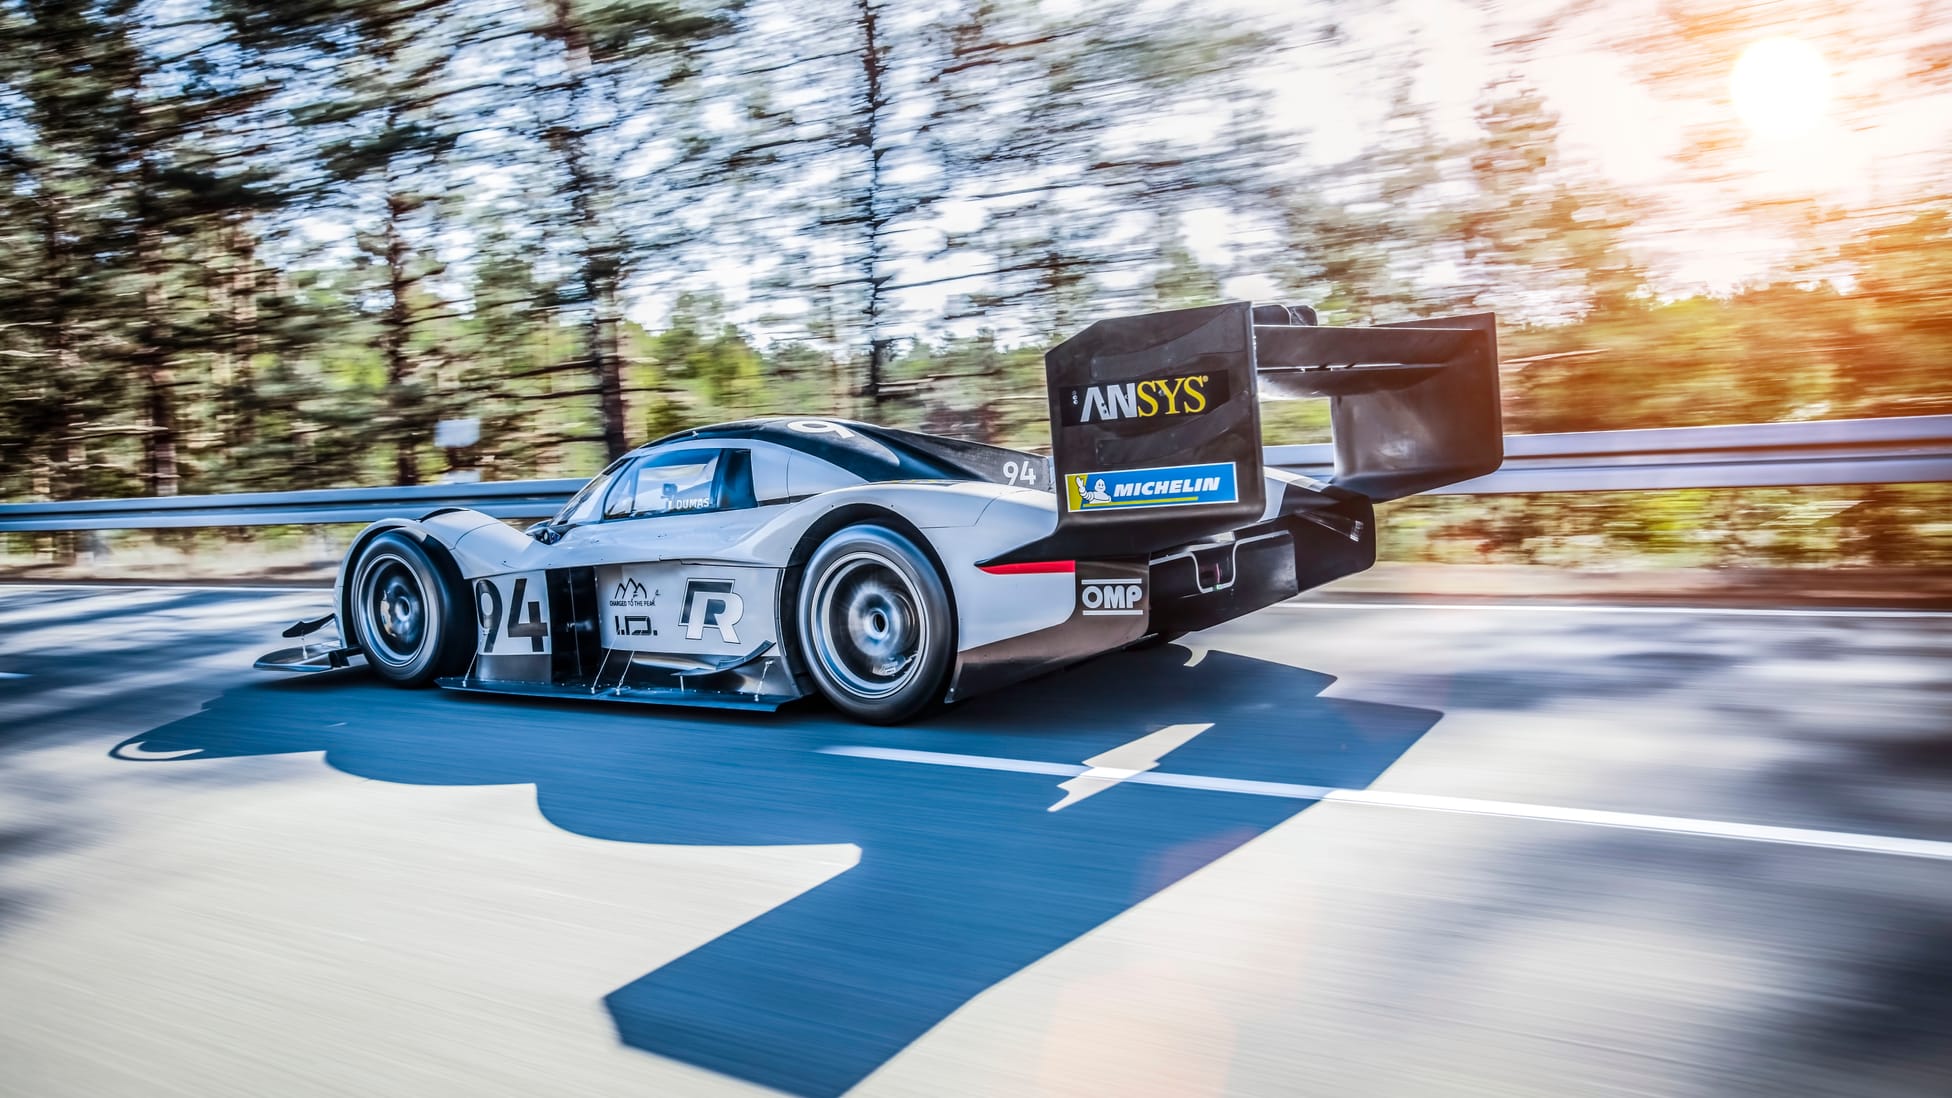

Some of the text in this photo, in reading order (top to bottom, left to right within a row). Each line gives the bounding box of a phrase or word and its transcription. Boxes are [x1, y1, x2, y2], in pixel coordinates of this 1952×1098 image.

[1002, 461, 1037, 486] 94
[1113, 476, 1221, 498] MICHELIN
[676, 497, 710, 510] DUMAS
[1082, 584, 1143, 609] OMP
[475, 577, 549, 653] 94
[678, 577, 745, 644] R
